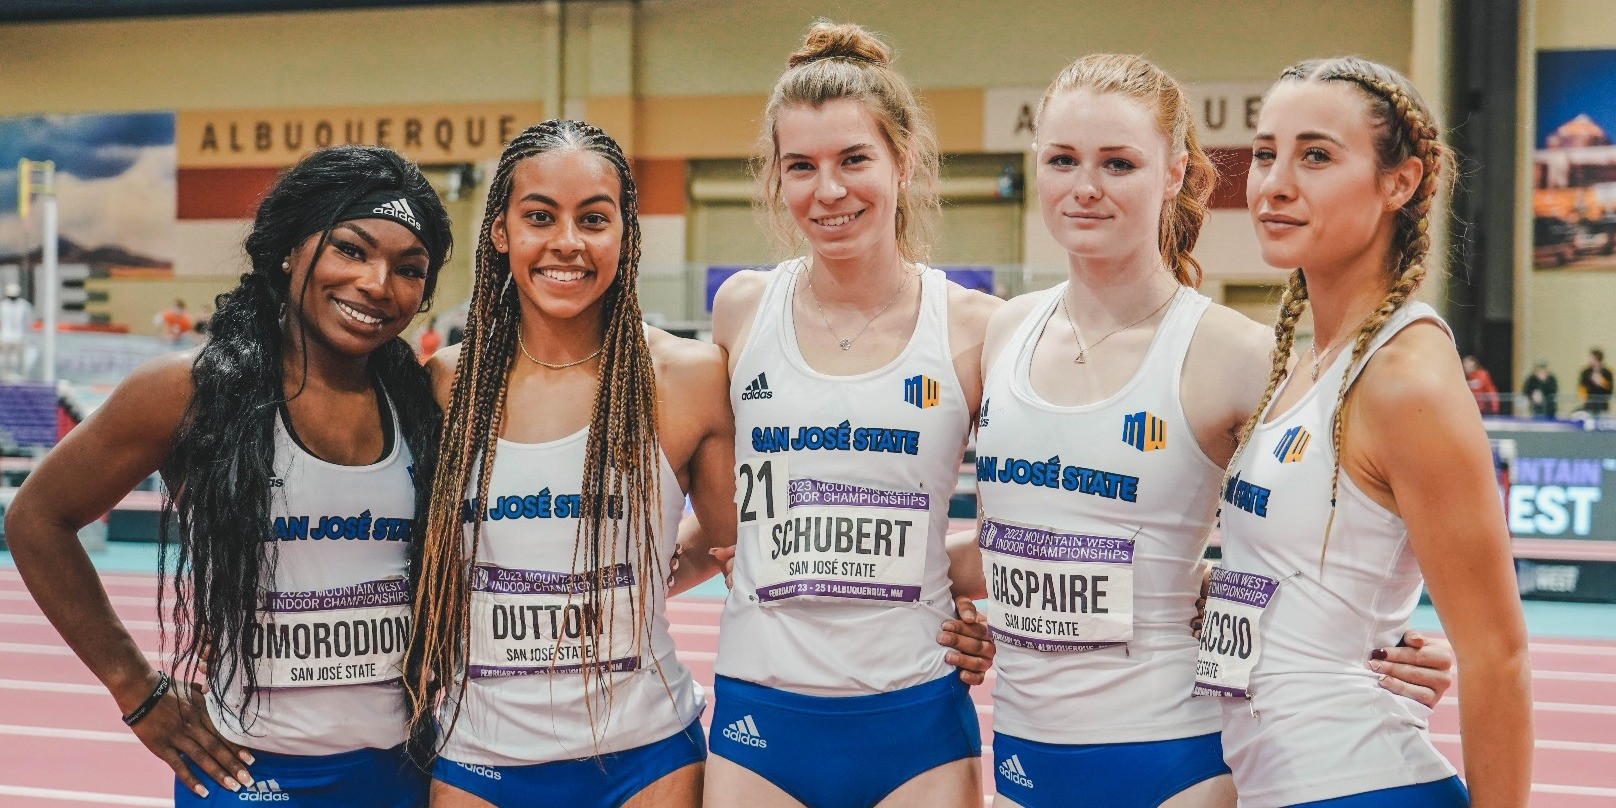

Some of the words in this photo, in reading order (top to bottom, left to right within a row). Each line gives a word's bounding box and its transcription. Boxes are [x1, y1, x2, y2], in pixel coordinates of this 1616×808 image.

[200, 114, 515, 152] ALBUQUERQUE
[372, 207, 421, 231] adidas
[741, 389, 773, 401] adidas
[751, 426, 790, 453] SAN
[790, 419, 851, 451] JOSÉ
[852, 427, 920, 455] STATE
[975, 456, 998, 482] AN
[998, 455, 1061, 489] JOSÉ
[1062, 465, 1140, 503] STATE
[1515, 457, 1603, 484] NTAIN
[739, 460, 775, 523] 21
[789, 491, 820, 505] DOOR
[823, 491, 927, 507] CHAMPIONSHIPS
[489, 487, 551, 521] JOSÉ
[1508, 484, 1602, 536] EST
[271, 516, 310, 541] AN
[309, 509, 372, 541] JOSÉ
[771, 516, 913, 560] SCHUBERT
[995, 538, 1025, 554] INDOOR
[1026, 544, 1130, 561] CHAMPIONSHIPS
[1003, 527, 1025, 540] 2023
[1024, 531, 1083, 547] MOUNTAIN
[1086, 538, 1124, 549] WEST
[498, 569, 523, 581] 2023
[789, 560, 809, 576] SAN
[811, 558, 838, 576] JOSÉ
[841, 561, 876, 578] STATE
[377, 581, 402, 593] WEST
[491, 580, 531, 592] INDOOR
[797, 583, 808, 592] 23
[814, 584, 826, 593] 25
[991, 562, 1110, 614] GASPAIRE
[1240, 574, 1269, 591] WEST
[272, 597, 320, 610] INDOOR
[323, 590, 410, 608] CHAMPIONSHIPS
[492, 604, 604, 641] DUTTON
[1005, 612, 1020, 630] SAN
[1021, 615, 1044, 634] JOSÉ
[1045, 620, 1080, 637] STATE
[247, 615, 410, 661] OMORODION
[1200, 610, 1252, 660] ACCIO
[506, 648, 527, 662] SAN
[530, 645, 555, 662] JOSÉ
[558, 644, 595, 660] STATE
[290, 667, 314, 682] SAN
[317, 662, 343, 681] JOSÉ
[345, 663, 376, 679] STATE
[722, 728, 767, 748] adidas
[998, 765, 1034, 788] adidas
[238, 790, 290, 802] adidas
